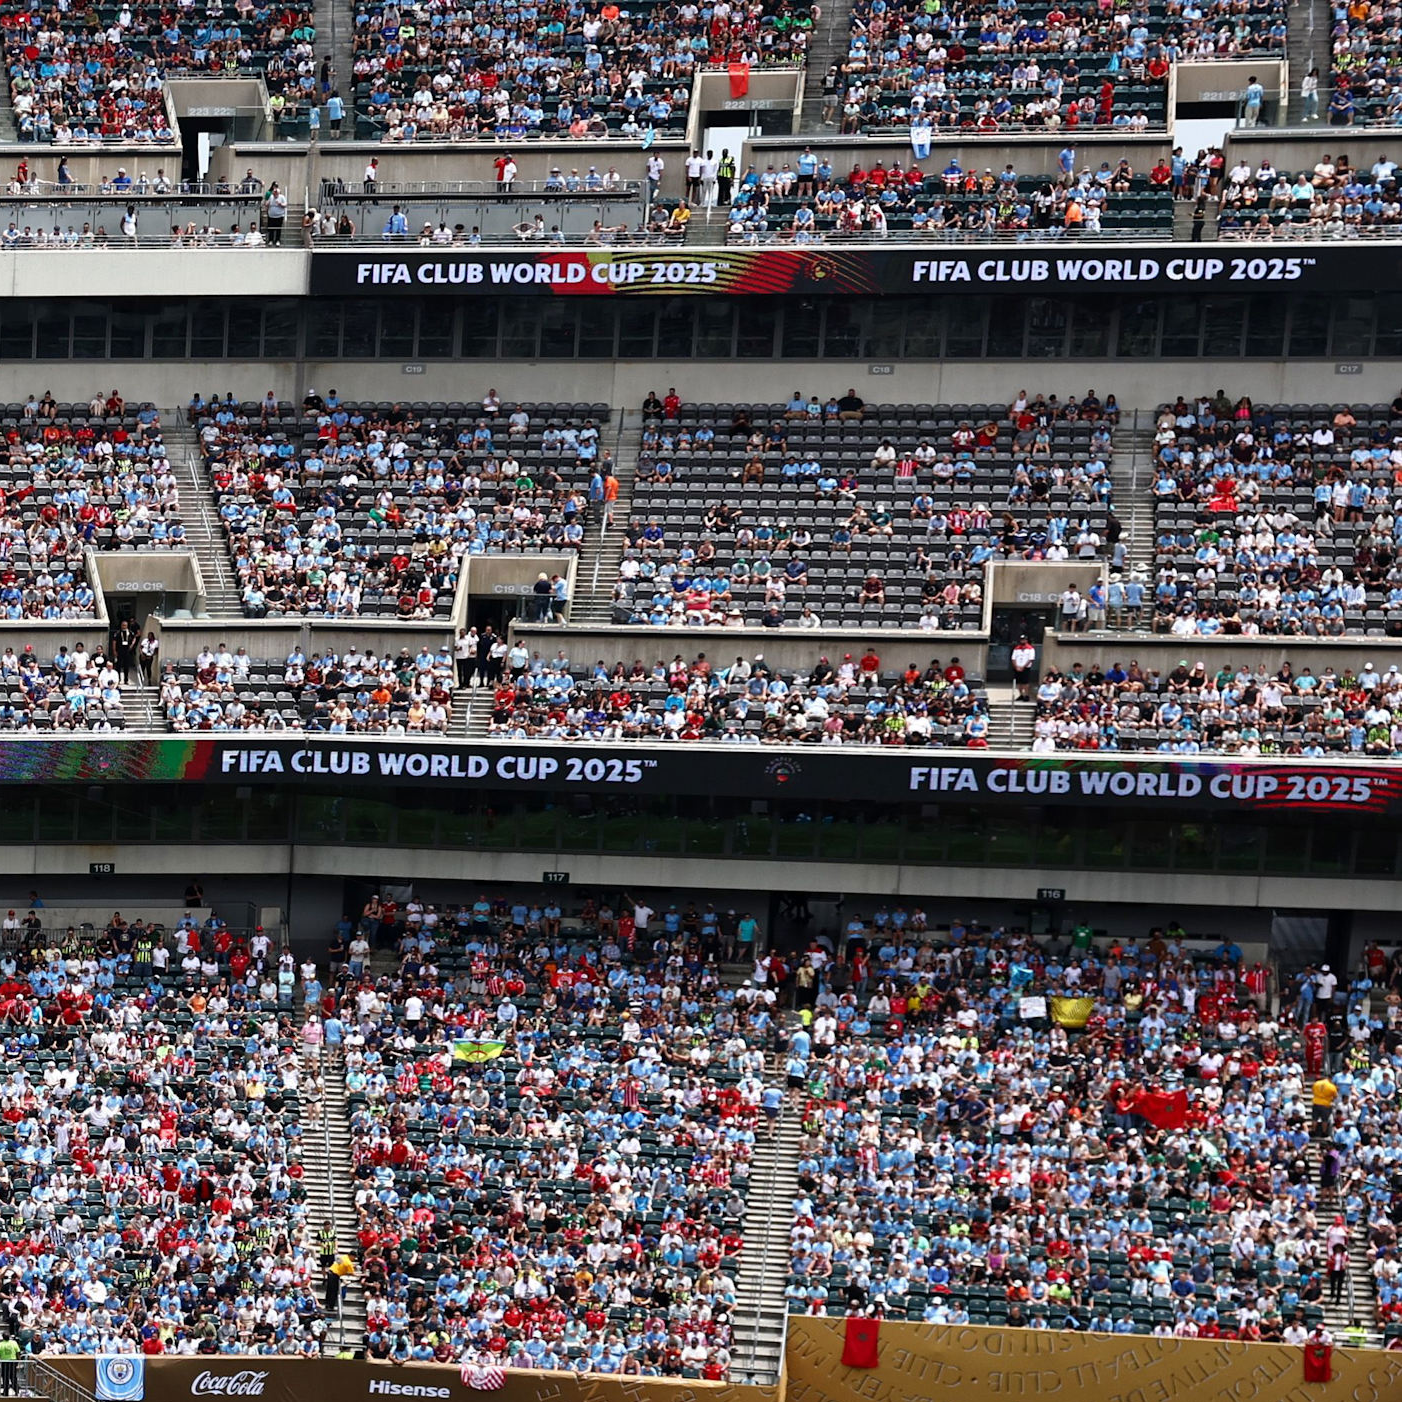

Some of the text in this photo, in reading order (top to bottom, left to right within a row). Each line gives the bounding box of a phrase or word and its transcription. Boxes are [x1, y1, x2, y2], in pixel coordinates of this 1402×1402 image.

[357, 263, 412, 284] FIFA
[417, 263, 484, 284] CLUB
[490, 263, 586, 284] WORLD
[592, 262, 645, 284] CUP
[913, 260, 972, 282] FIFA
[977, 260, 1049, 281] CLUB
[1056, 259, 1160, 281] WORLD
[1166, 258, 1224, 280] CUP
[495, 584, 515, 594] C19
[222, 750, 284, 772] FIFA
[291, 750, 371, 774] CLUB
[379, 753, 489, 778] WORLD
[497, 756, 559, 780] CUP
[910, 767, 978, 792] FIFA
[987, 768, 1070, 794] CLUB
[1080, 771, 1198, 799] WORLD
[1210, 773, 1277, 799] CUP
[94, 863, 111, 873] 118
[547, 873, 565, 881] 117
[1040, 889, 1062, 898] 116
[369, 1379, 451, 1399] Hisense
